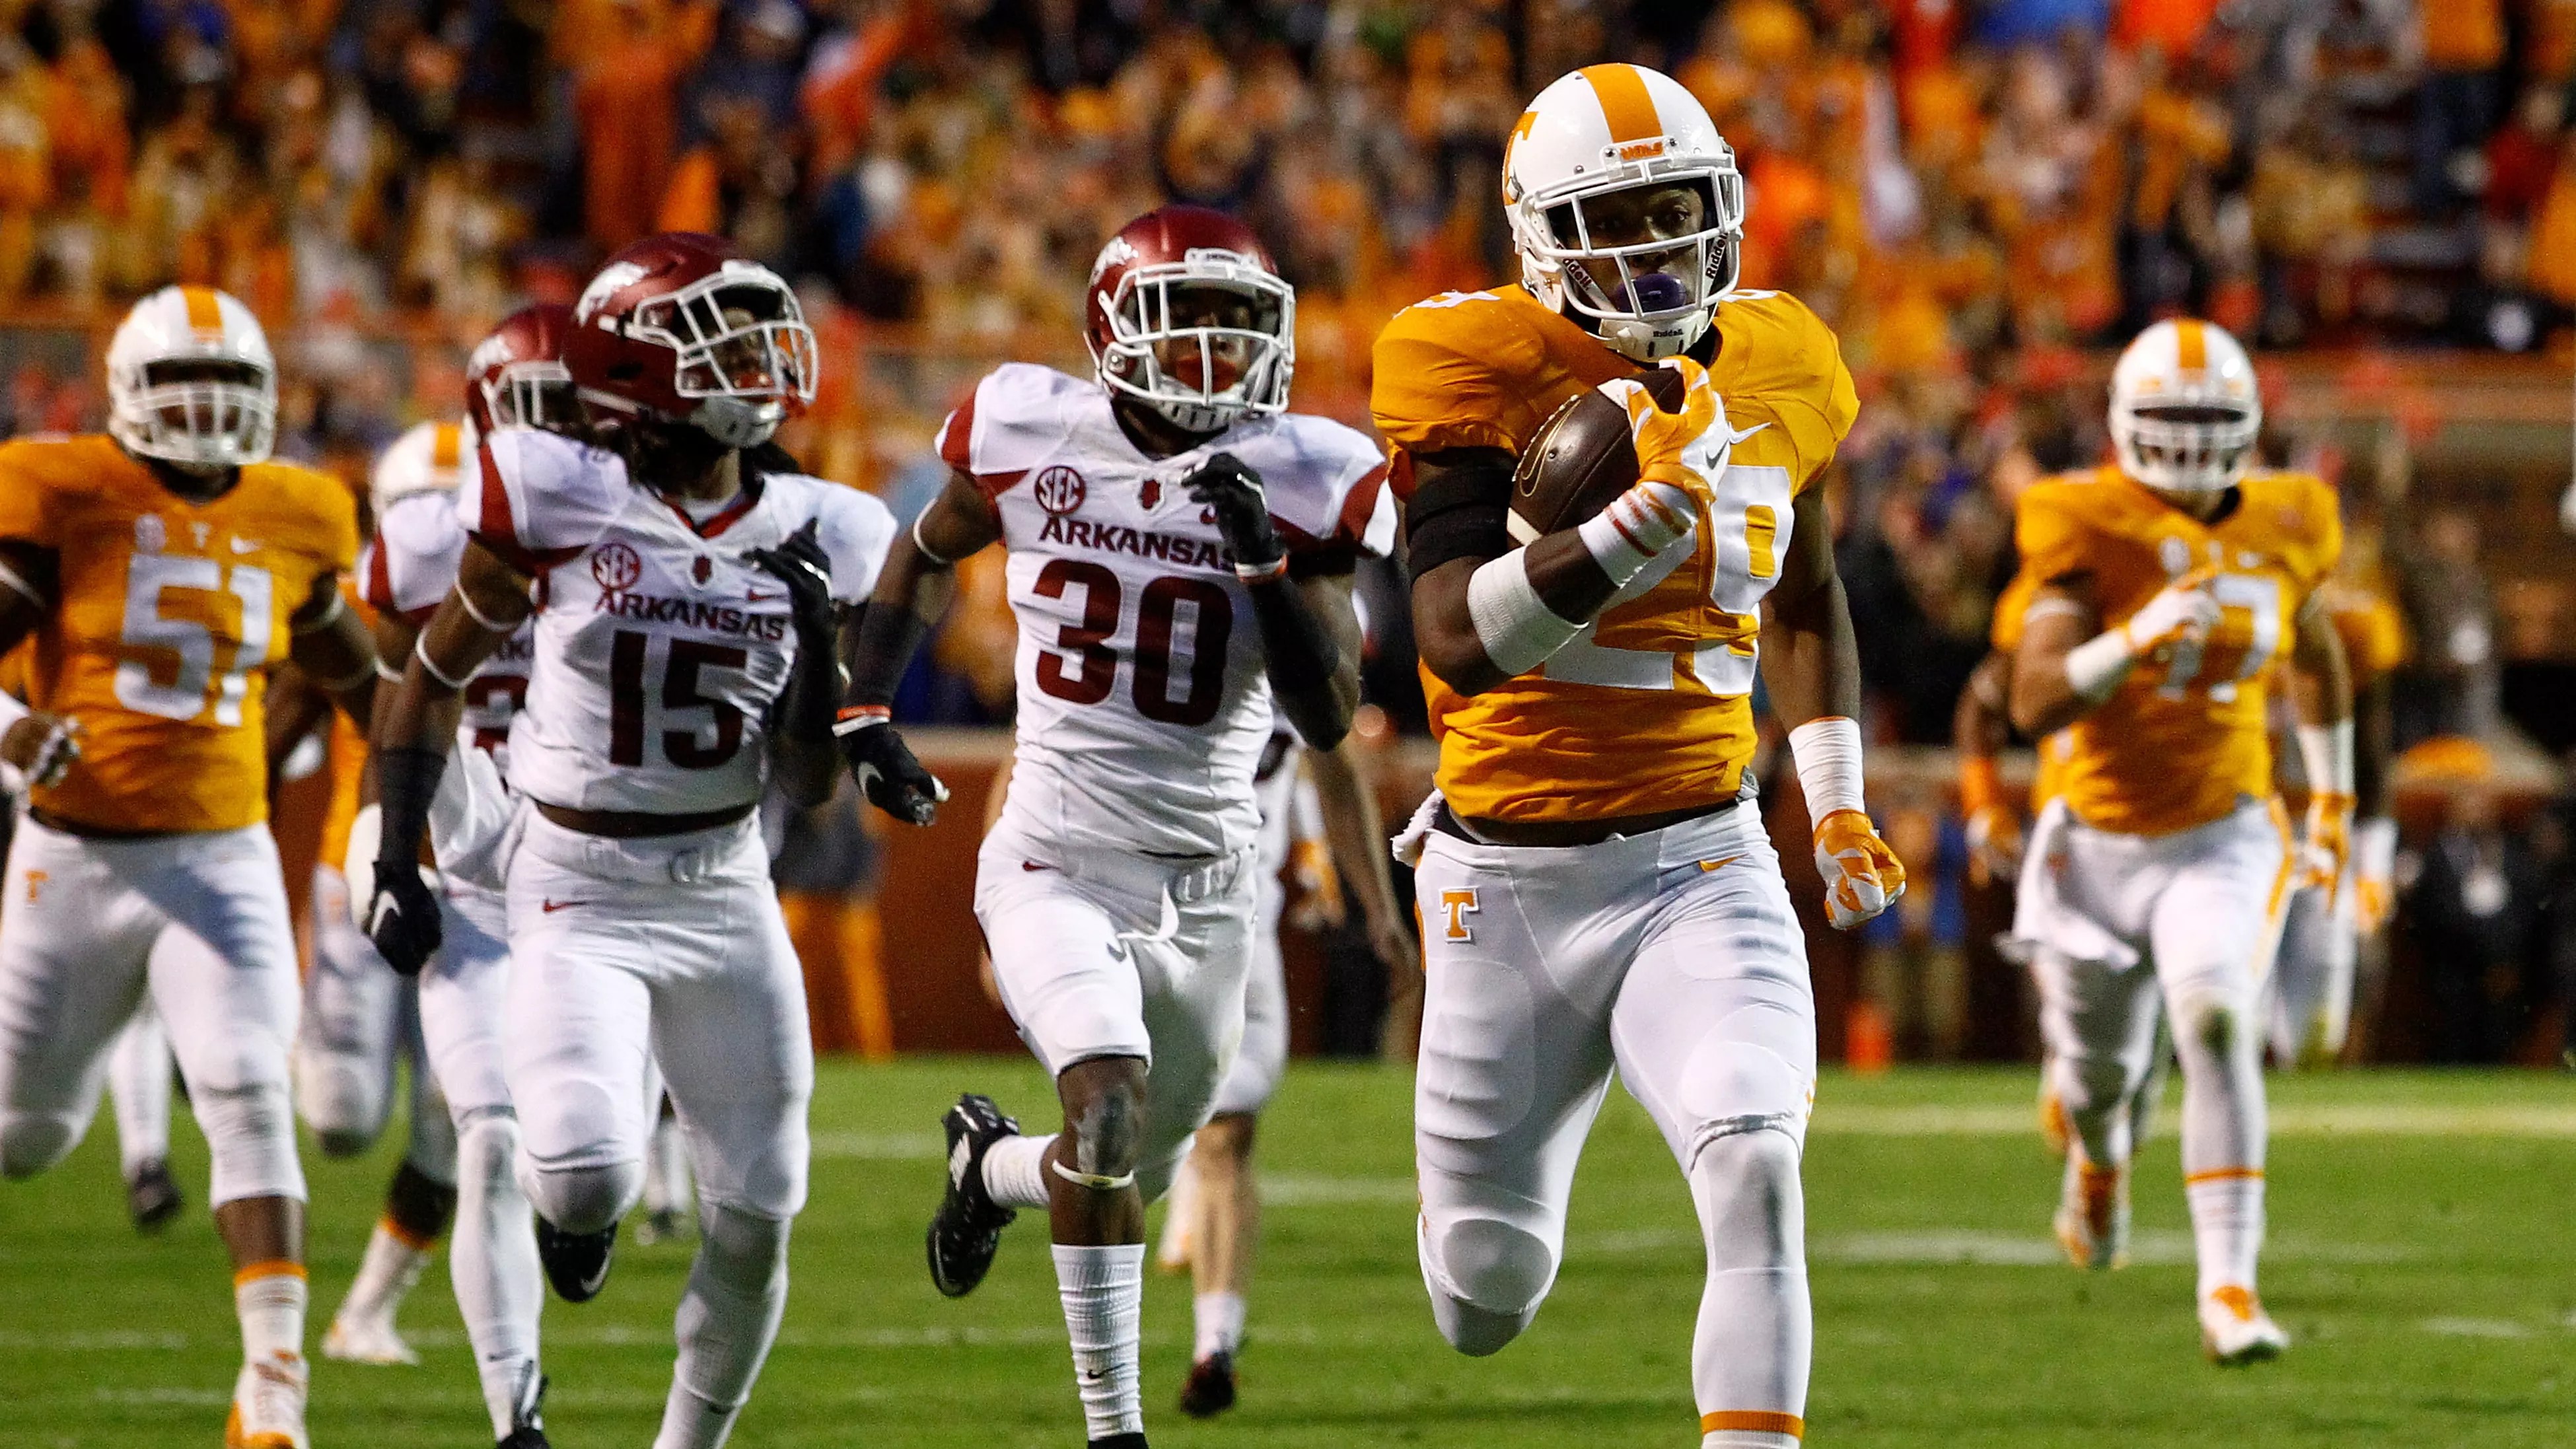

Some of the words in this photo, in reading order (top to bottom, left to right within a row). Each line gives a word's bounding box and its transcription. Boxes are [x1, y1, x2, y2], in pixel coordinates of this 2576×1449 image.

[1036, 467, 1085, 513] SEC
[114, 552, 272, 726] 51
[594, 590, 784, 641] ARKANSAS
[1032, 558, 1233, 726] 30
[610, 629, 748, 769] 15
[1440, 888, 1478, 940] T
